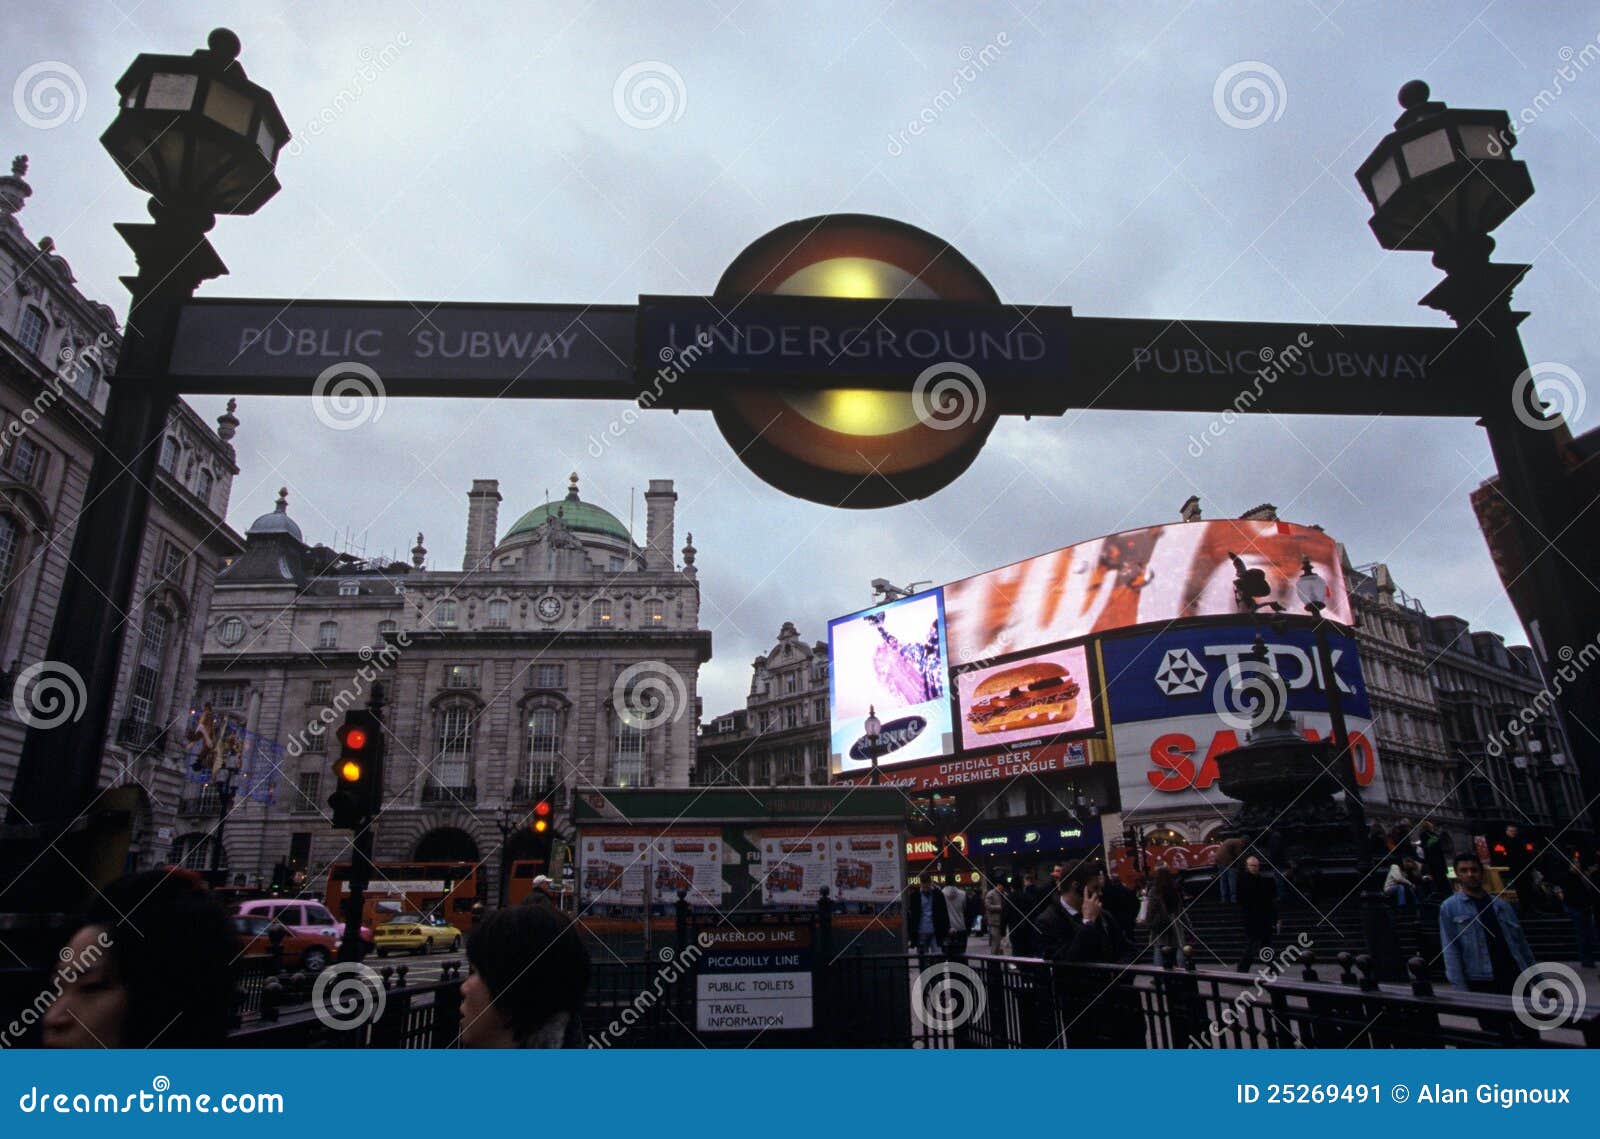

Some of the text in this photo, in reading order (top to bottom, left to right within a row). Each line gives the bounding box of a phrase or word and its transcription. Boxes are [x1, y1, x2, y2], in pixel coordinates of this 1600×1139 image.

[239, 327, 579, 360] PUBLIC SUBWAY
[669, 322, 1047, 361] UNDERGROUND
[1133, 347, 1430, 379] PUBLIC SUBWAY
[1204, 644, 1354, 694] TDK
[940, 751, 1031, 775] OFFICIAL BEER
[1147, 729, 1375, 792] SAO
[923, 759, 1057, 788] F.A. PREMIER LEAGUE
[981, 836, 1008, 846] pharmacy
[1060, 829, 1081, 839] beauty
[708, 930, 796, 943] BAKERLOO LINE
[708, 954, 800, 967] PICCADILLY LINE
[708, 980, 794, 993] PUBLIC TOILETS
[708, 1003, 748, 1015] TRAVEL
[707, 1015, 784, 1028] INFORMATION
